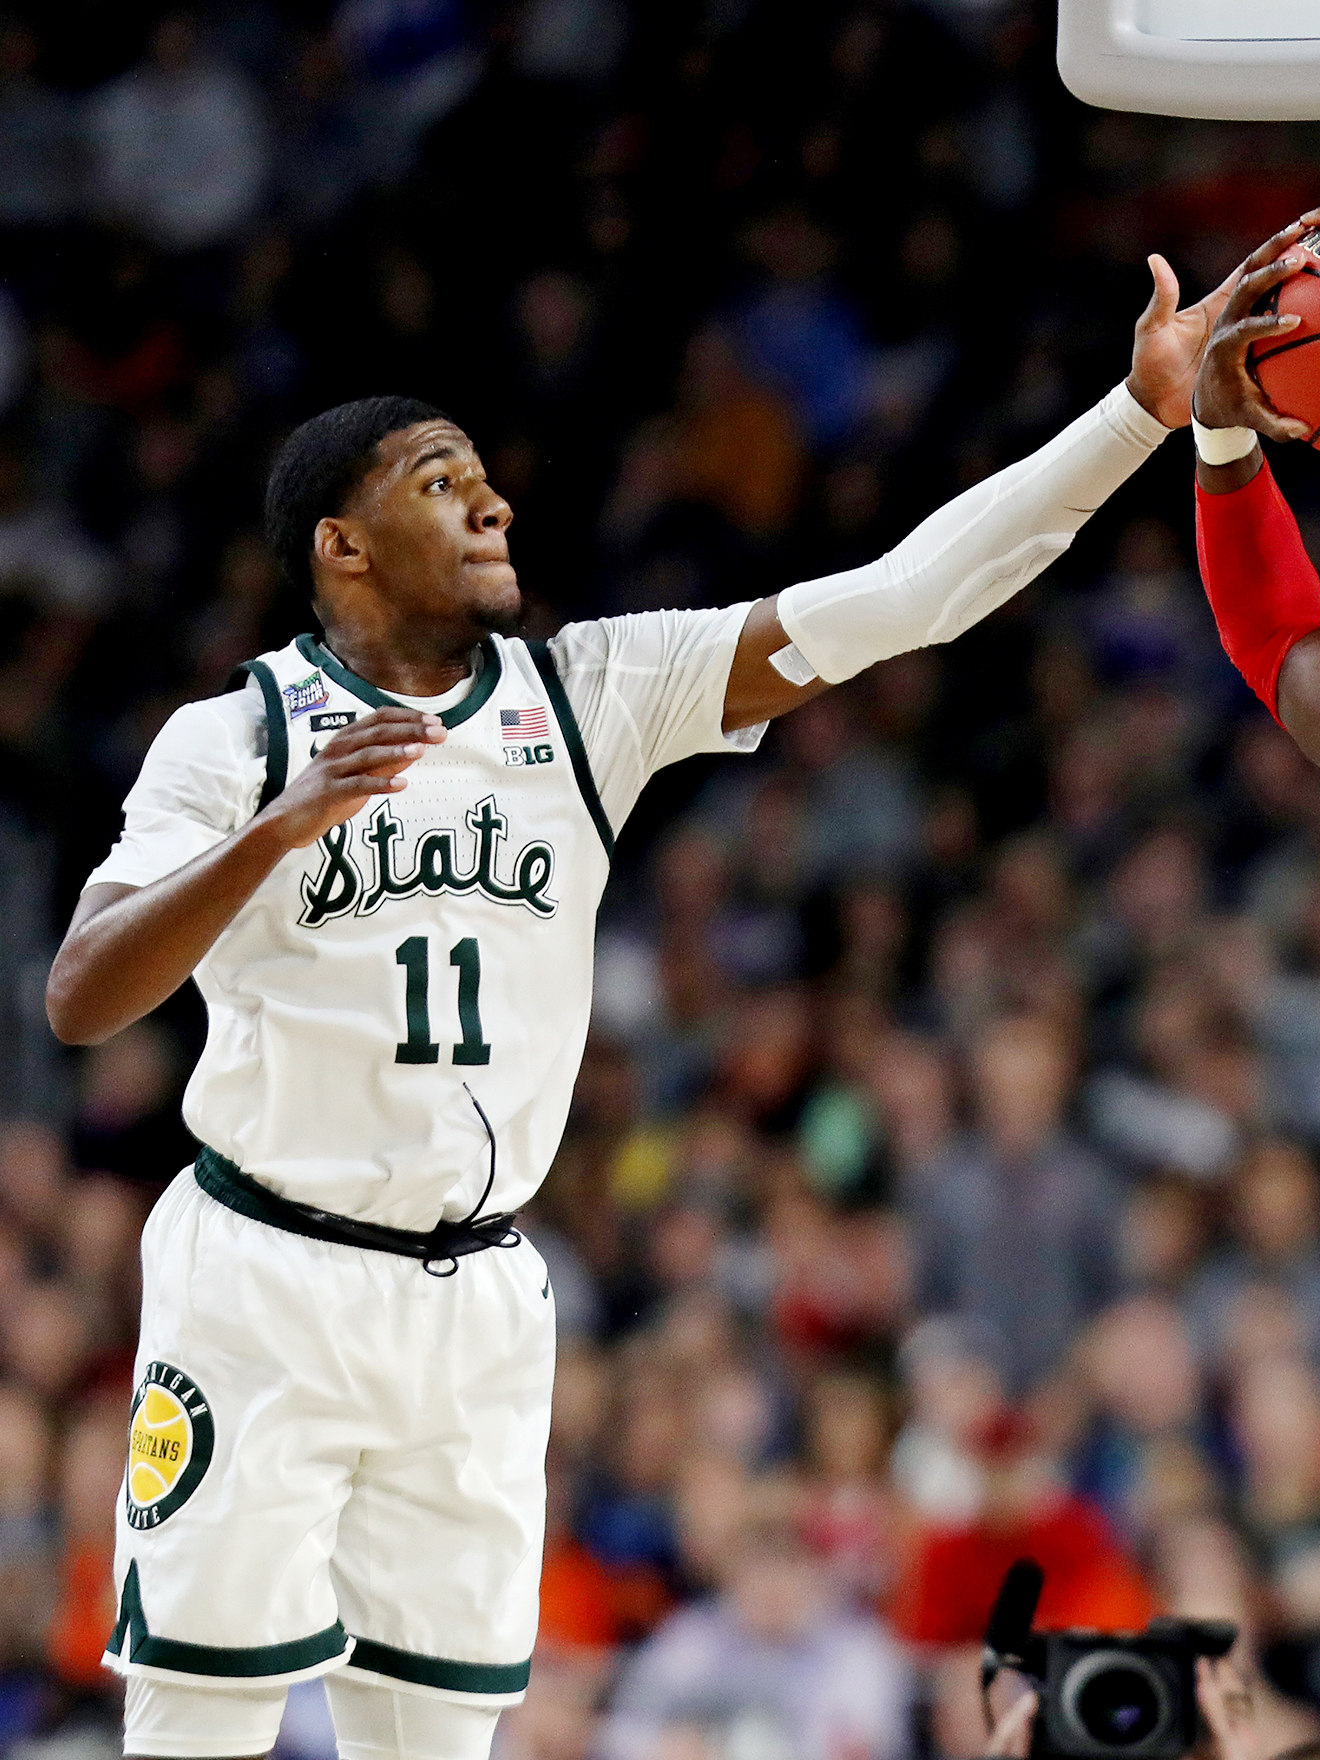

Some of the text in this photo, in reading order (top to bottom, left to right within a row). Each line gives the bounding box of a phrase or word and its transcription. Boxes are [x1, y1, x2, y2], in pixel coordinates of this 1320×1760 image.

[288, 679, 323, 700] FINAL
[289, 688, 324, 710] FOUR
[319, 714, 349, 727] GUS
[296, 793, 560, 929] State
[394, 935, 492, 1066] 11
